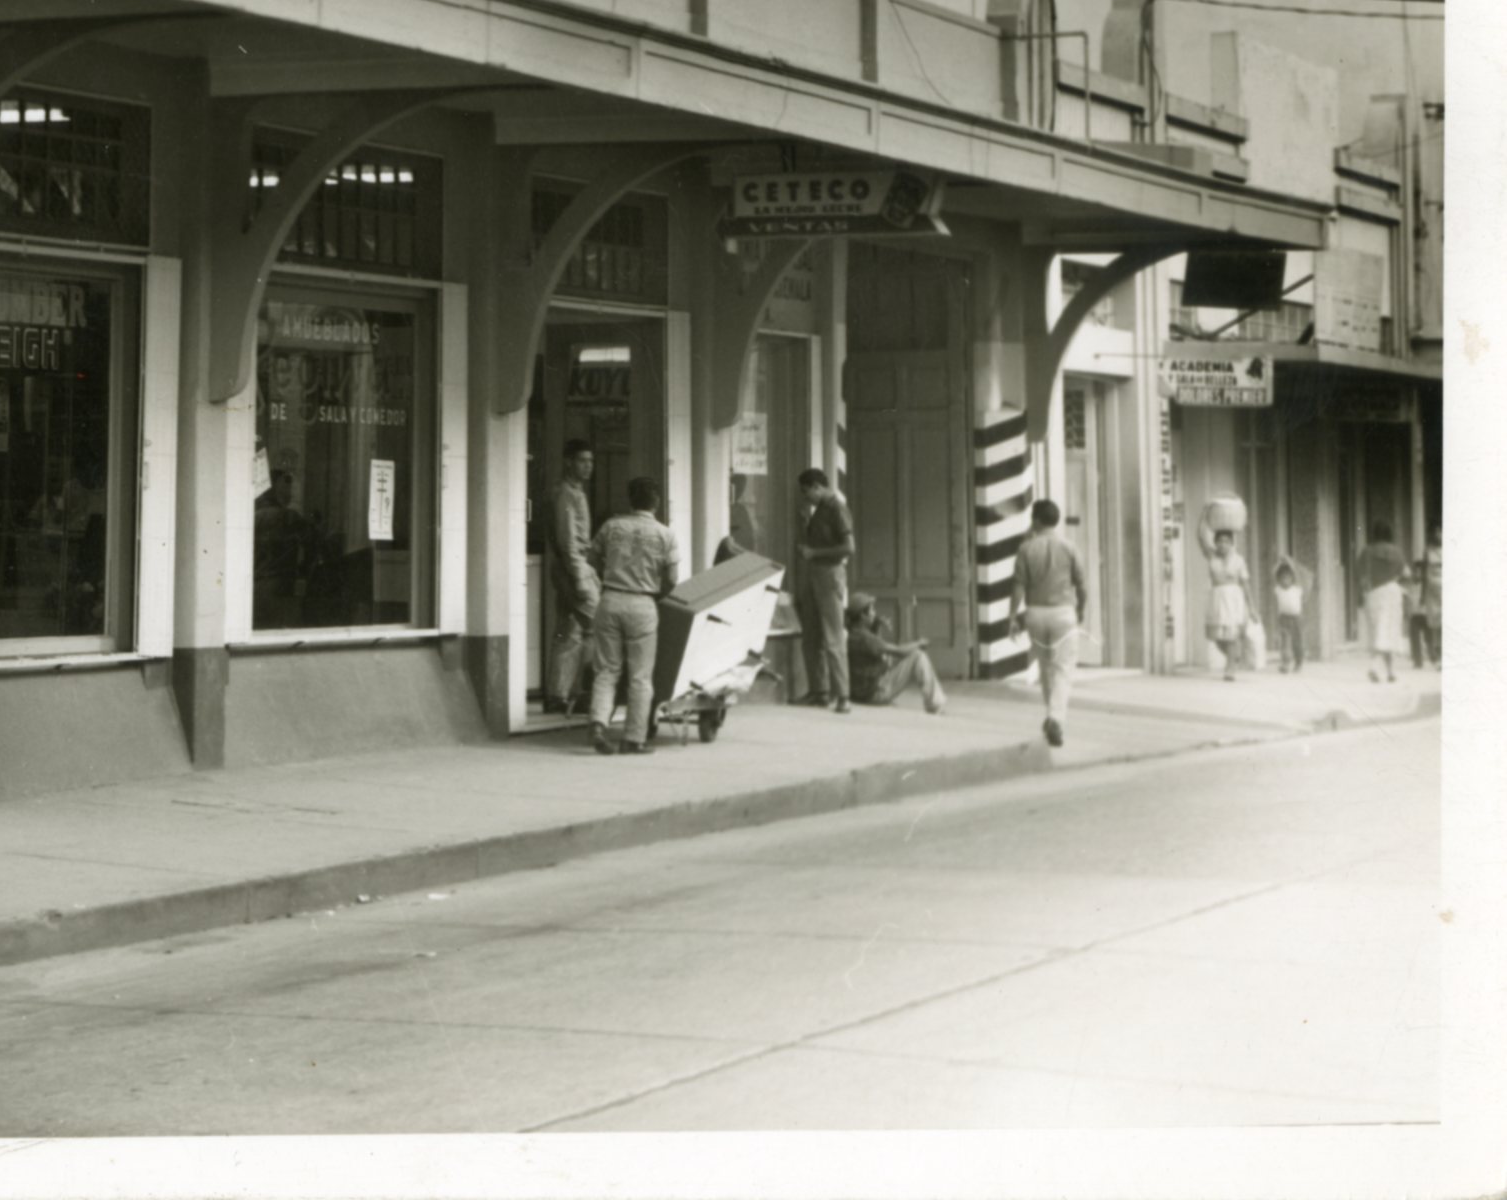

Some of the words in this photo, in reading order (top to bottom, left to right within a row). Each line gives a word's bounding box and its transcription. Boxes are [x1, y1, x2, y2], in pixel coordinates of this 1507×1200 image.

[742, 178, 871, 203] CETECO
[282, 314, 381, 345] AMUEBLADOS
[1170, 360, 1235, 373] ACADEMIA
[270, 402, 288, 421] DE
[319, 405, 348, 424] SALA
